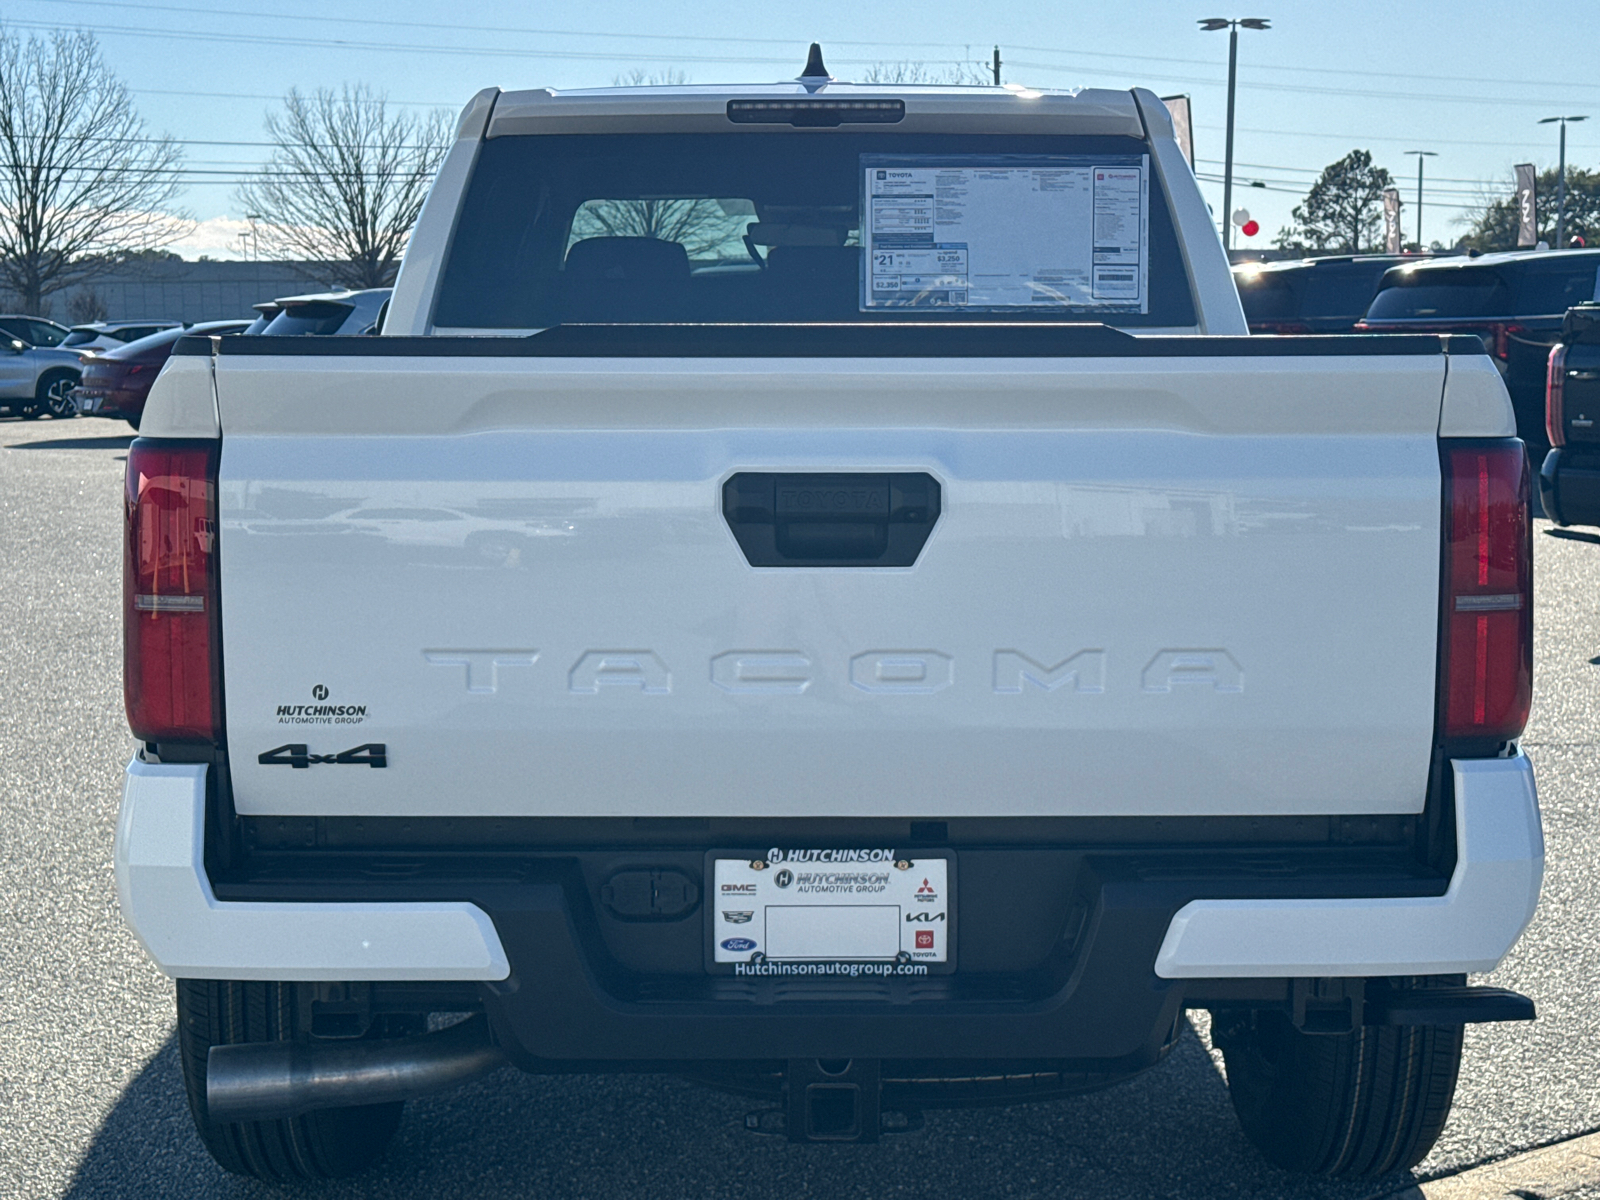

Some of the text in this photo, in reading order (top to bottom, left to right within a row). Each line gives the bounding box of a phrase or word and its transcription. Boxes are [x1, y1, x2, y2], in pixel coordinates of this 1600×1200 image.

[879, 254, 893, 266] 21
[937, 255, 960, 263] $3,250
[782, 490, 883, 509] TOYOTA
[422, 648, 1246, 695] TACOMA
[276, 705, 367, 716] HUTCHINSON
[787, 849, 895, 862] HUTCHINSON
[796, 872, 890, 885] HUTCHINSON
[797, 885, 886, 893] AUTOMOTIVE GROUP
[727, 940, 750, 949] Ford
[735, 962, 928, 977] Hutchinsonautogroup.com
